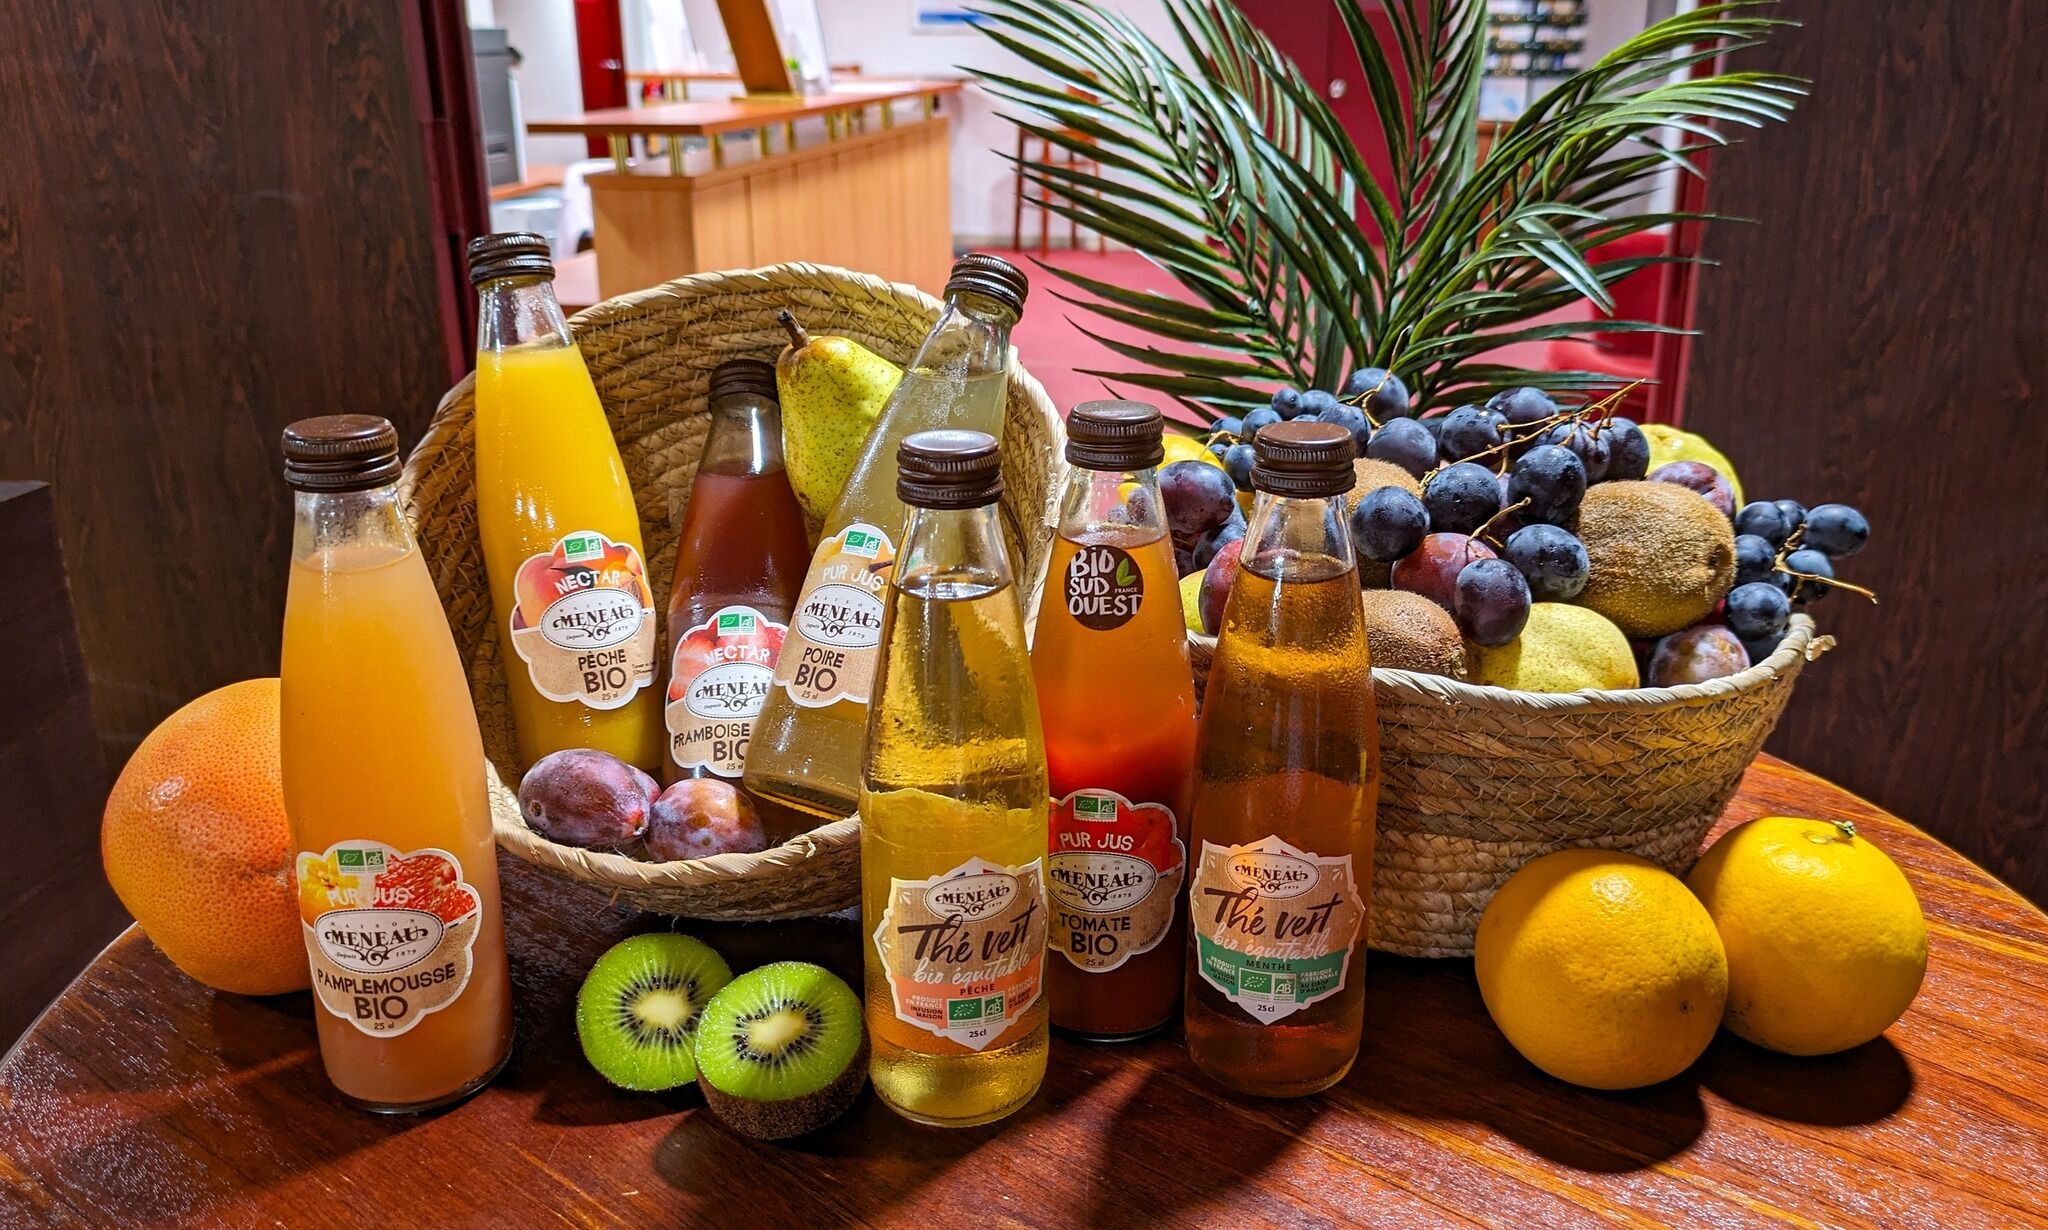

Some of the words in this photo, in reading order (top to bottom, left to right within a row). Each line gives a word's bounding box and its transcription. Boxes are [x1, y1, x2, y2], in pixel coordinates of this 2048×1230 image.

[553, 570, 621, 595] NECTAR
[822, 564, 848, 582] PUR
[851, 567, 884, 591] JUS
[1069, 577, 1110, 596] SUD
[804, 602, 881, 629] MENEAU
[1069, 594, 1143, 616] OUEST
[552, 606, 634, 628] MENEAU
[578, 649, 627, 671] PÊCHE
[704, 645, 770, 665] NECTAR
[802, 647, 845, 669] POIRE
[583, 666, 627, 694] BIO
[794, 663, 837, 692] BIO
[801, 690, 811, 699] 25
[673, 723, 750, 749] FRAMBOISE
[1060, 832, 1091, 849] PUR
[1097, 833, 1134, 851] JUS
[1050, 867, 1143, 889] MENEAU
[1235, 865, 1308, 881] MENEAU
[327, 888, 358, 906] PUR
[373, 886, 411, 904] JUS
[935, 885, 1010, 904] MENEAU
[1059, 912, 1131, 932] TOMATE
[1204, 886, 1267, 936] Thé
[1274, 893, 1343, 939] vert
[324, 925, 429, 947] MENEAU
[897, 913, 972, 963] Thé
[981, 898, 1038, 961] vert
[1071, 931, 1118, 956] BIO
[1212, 922, 1238, 951] bio
[1244, 928, 1331, 962] équitable
[912, 956, 945, 984] bio
[952, 936, 1031, 988] équitable
[1086, 958, 1096, 966] 25
[1246, 959, 1292, 971] MENTHE
[316, 962, 456, 995] PAMPLEMOUSSE
[960, 983, 996, 996] PÊCHE
[353, 995, 409, 1020] BIO
[911, 1006, 943, 1014] INFUSION
[916, 1012, 943, 1020] MAISON
[374, 1022, 385, 1030] 25
